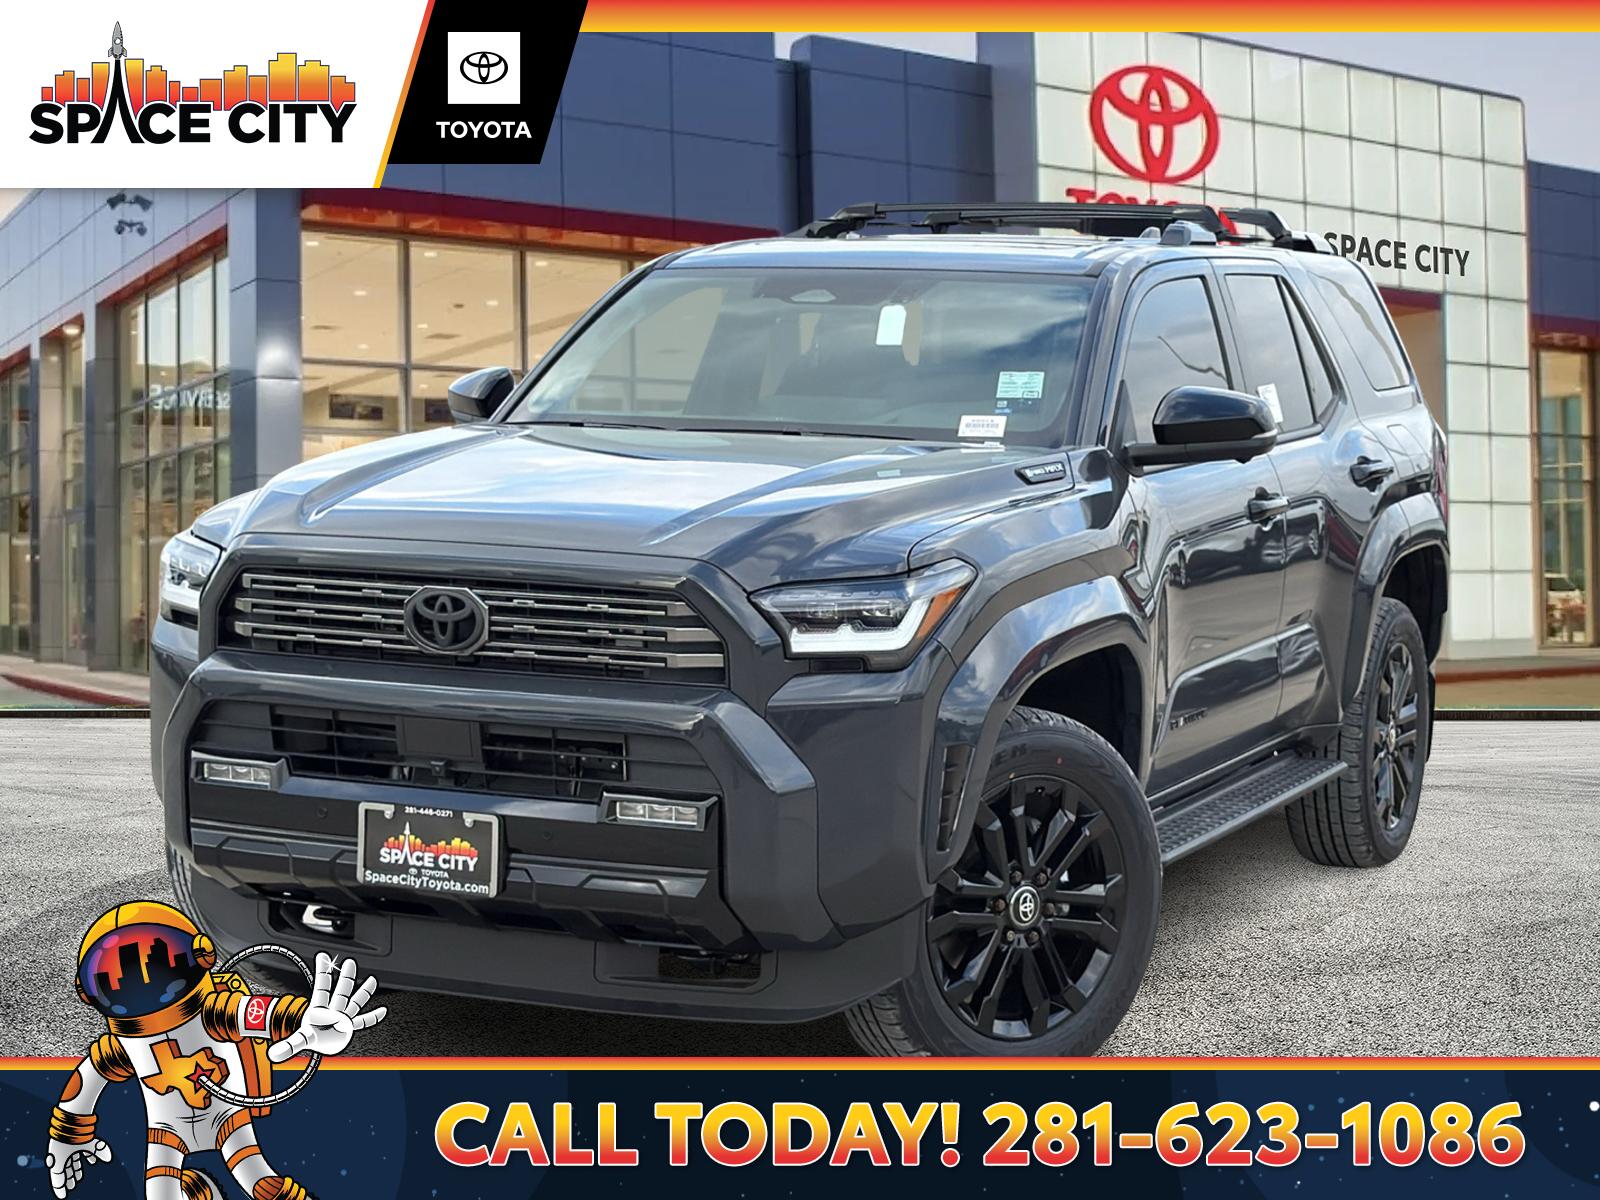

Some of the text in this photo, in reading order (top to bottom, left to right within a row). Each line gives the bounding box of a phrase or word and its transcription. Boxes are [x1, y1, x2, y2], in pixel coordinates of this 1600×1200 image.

[1324, 231, 1471, 277] SPACE CITY
[421, 868, 449, 879] TOYOTA
[438, 853, 479, 872] CITY
[365, 870, 489, 895] SpaceCityToyota.com
